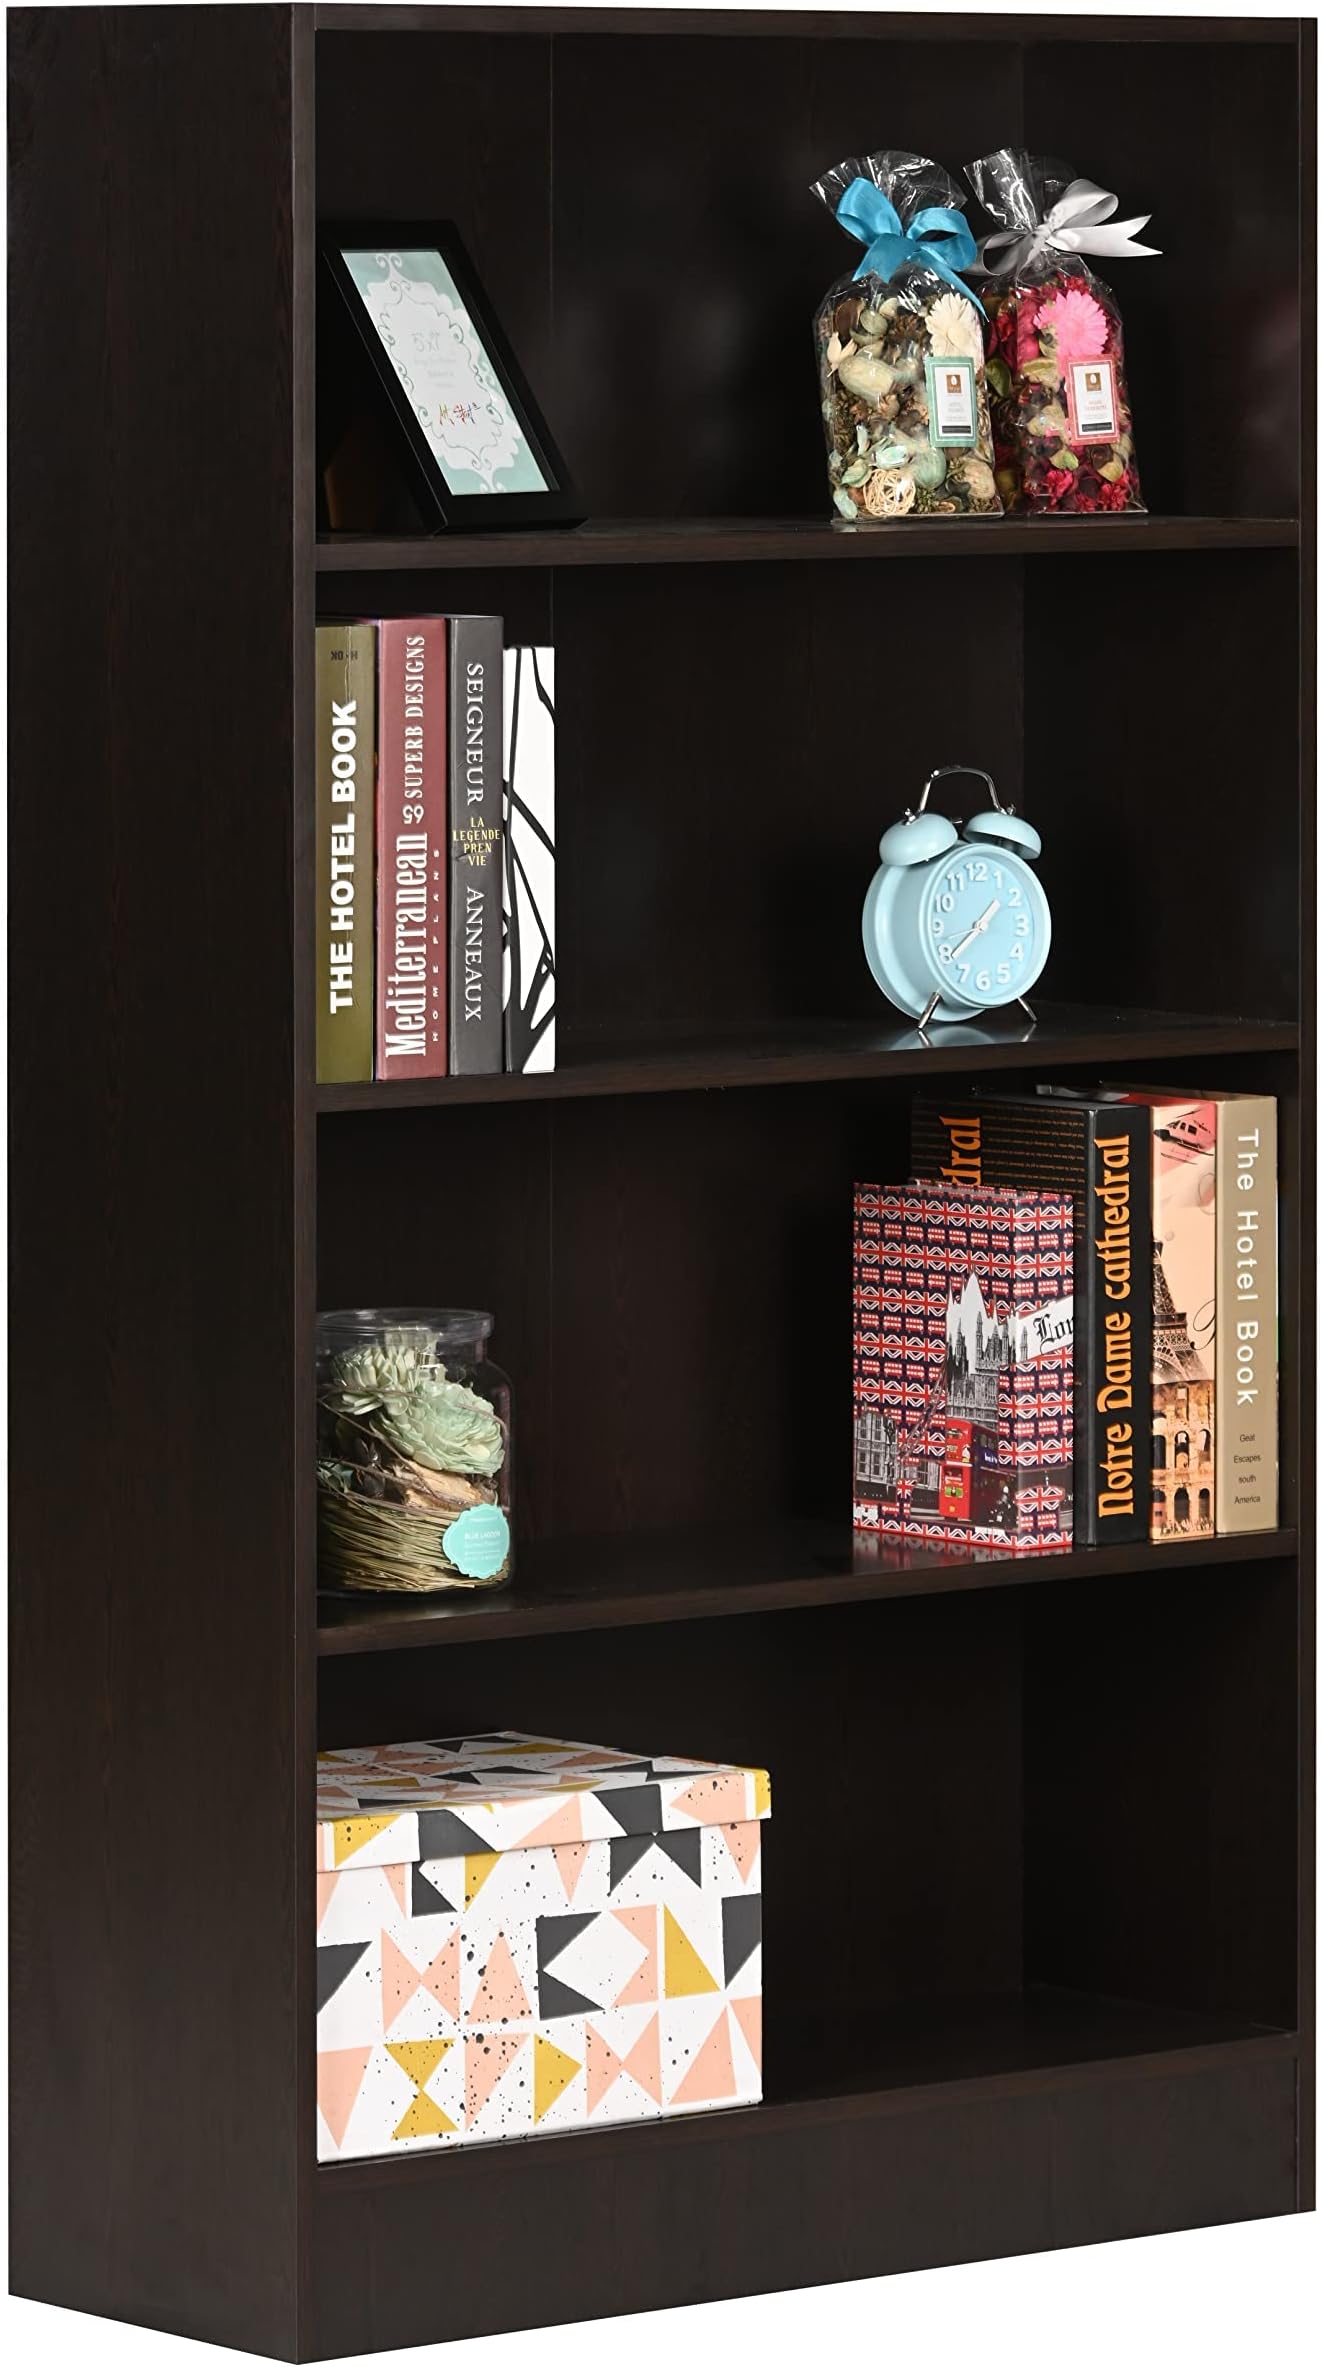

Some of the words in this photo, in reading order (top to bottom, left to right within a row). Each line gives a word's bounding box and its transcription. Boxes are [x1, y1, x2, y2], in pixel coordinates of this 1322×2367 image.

[405, 635, 425, 718] DESIGNS
[467, 662, 484, 806] SEIGNEUR
[331, 700, 357, 803] BOOK
[404, 725, 424, 799] SUPERB
[470, 816, 485, 828] LA
[452, 829, 501, 842] LEGENDE
[463, 842, 492, 854] PREN
[468, 855, 487, 866] VIE
[330, 812, 356, 931] HOTEL
[946, 871, 965, 891] 11
[965, 863, 988, 881] 12
[993, 870, 1003, 889] 1
[432, 850, 440, 945] PLANS
[935, 893, 954, 913] 10
[1008, 888, 1022, 907] 2
[931, 920, 945, 939] 9
[1015, 913, 1029, 937] 3
[385, 832, 428, 1058] Mediterranean
[465, 886, 484, 1022] ANNEAUX
[938, 944, 953, 965] 8
[1009, 942, 1024, 962] 4
[330, 942, 354, 1014] THE
[957, 963, 971, 983] 7
[976, 971, 991, 991] 6
[997, 963, 1011, 984] 5
[1237, 1128, 1259, 1191] The
[1094, 1134, 1131, 1300] cathedral
[1236, 1211, 1259, 1301] Hotel
[1096, 1311, 1132, 1413] Dame
[1236, 1321, 1259, 1406] Book
[1233, 1454, 1262, 1464] Escapes
[1098, 1423, 1134, 1518] Notre
[1233, 1495, 1261, 1505] America
